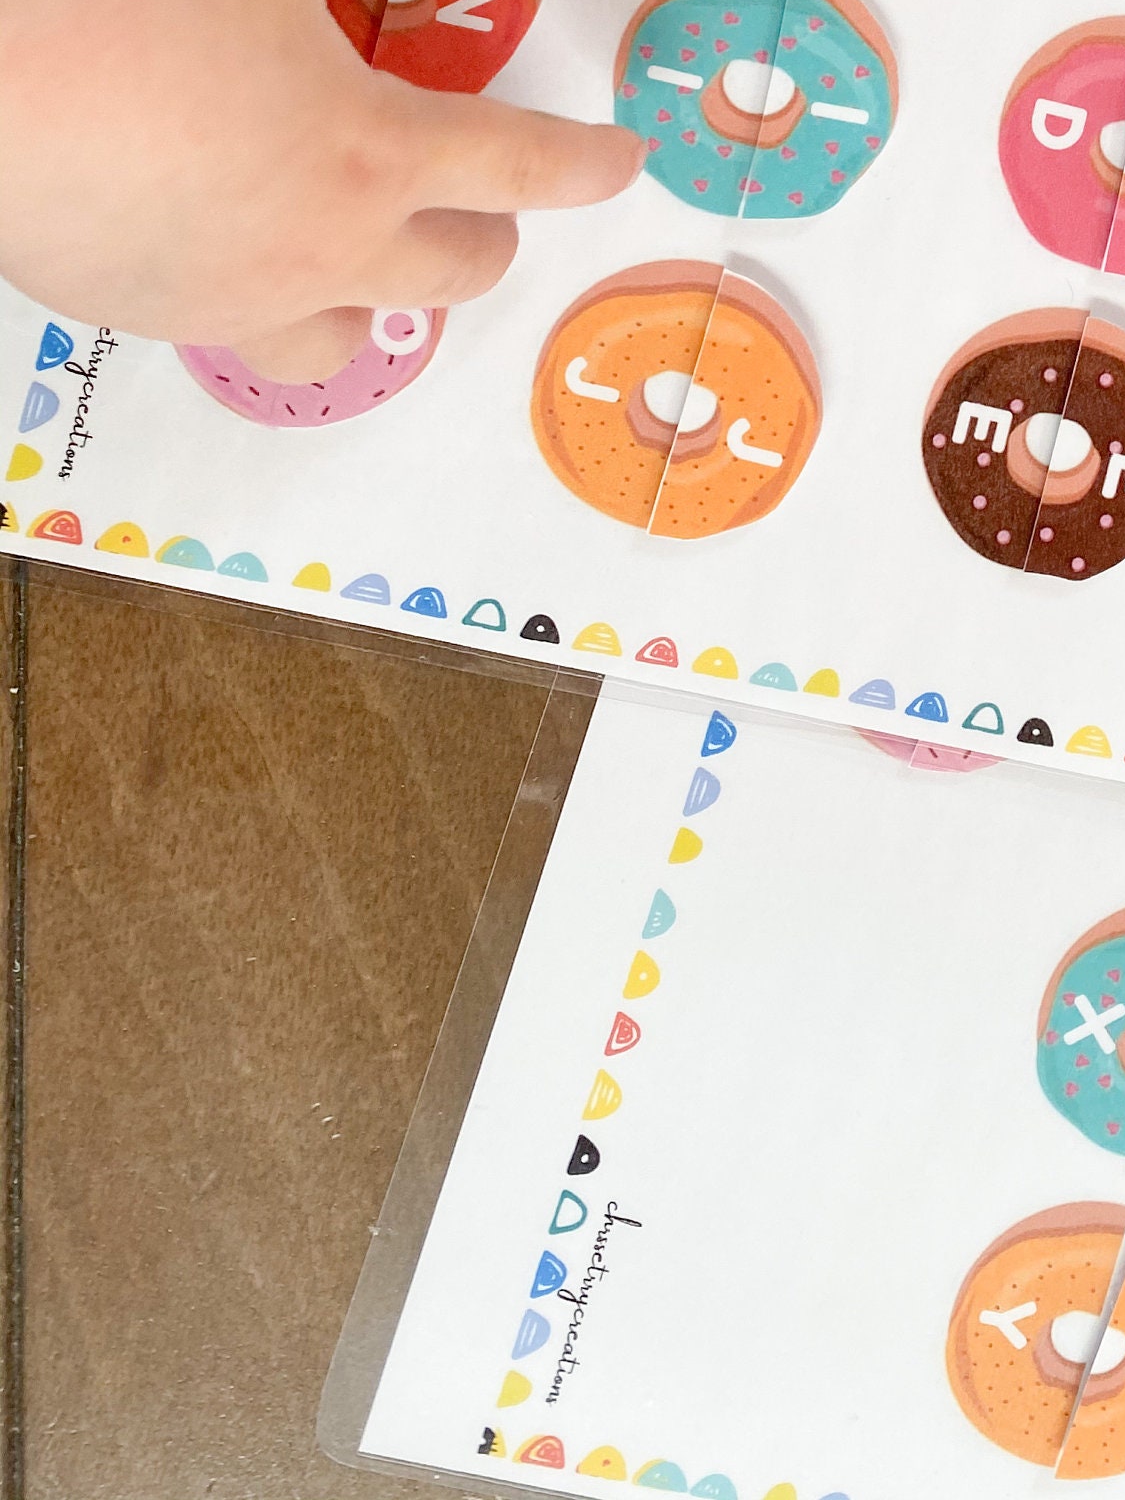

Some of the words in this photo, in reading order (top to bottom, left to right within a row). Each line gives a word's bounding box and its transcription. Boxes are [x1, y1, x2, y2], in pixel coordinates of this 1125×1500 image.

[647, 65, 704, 90] I
[810, 102, 869, 125] I
[1031, 98, 1088, 150] D
[370, 308, 429, 356] O
[565, 356, 620, 403] J
[726, 418, 783, 467] J
[951, 400, 1013, 453] E
[1063, 994, 1125, 1054] X
[979, 1301, 1037, 1350] Y
